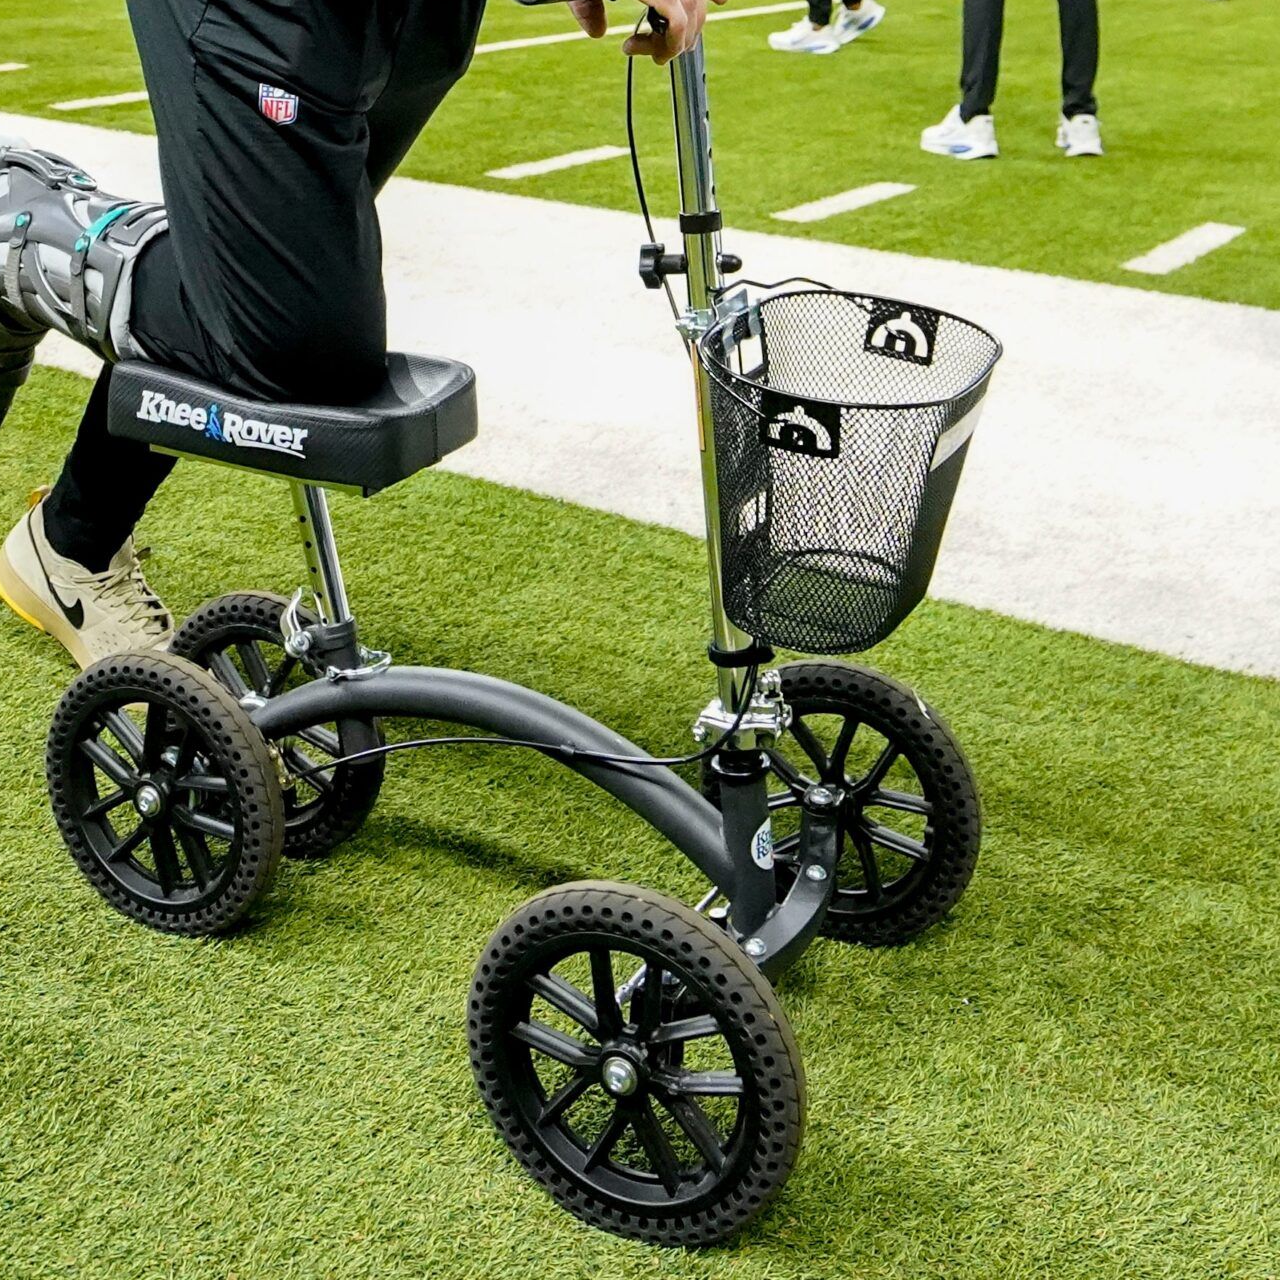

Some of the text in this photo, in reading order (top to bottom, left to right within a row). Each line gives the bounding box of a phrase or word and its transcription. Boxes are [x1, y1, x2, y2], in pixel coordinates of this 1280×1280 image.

[263, 99, 293, 120] NFL
[136, 389, 309, 457] Knee Rover
